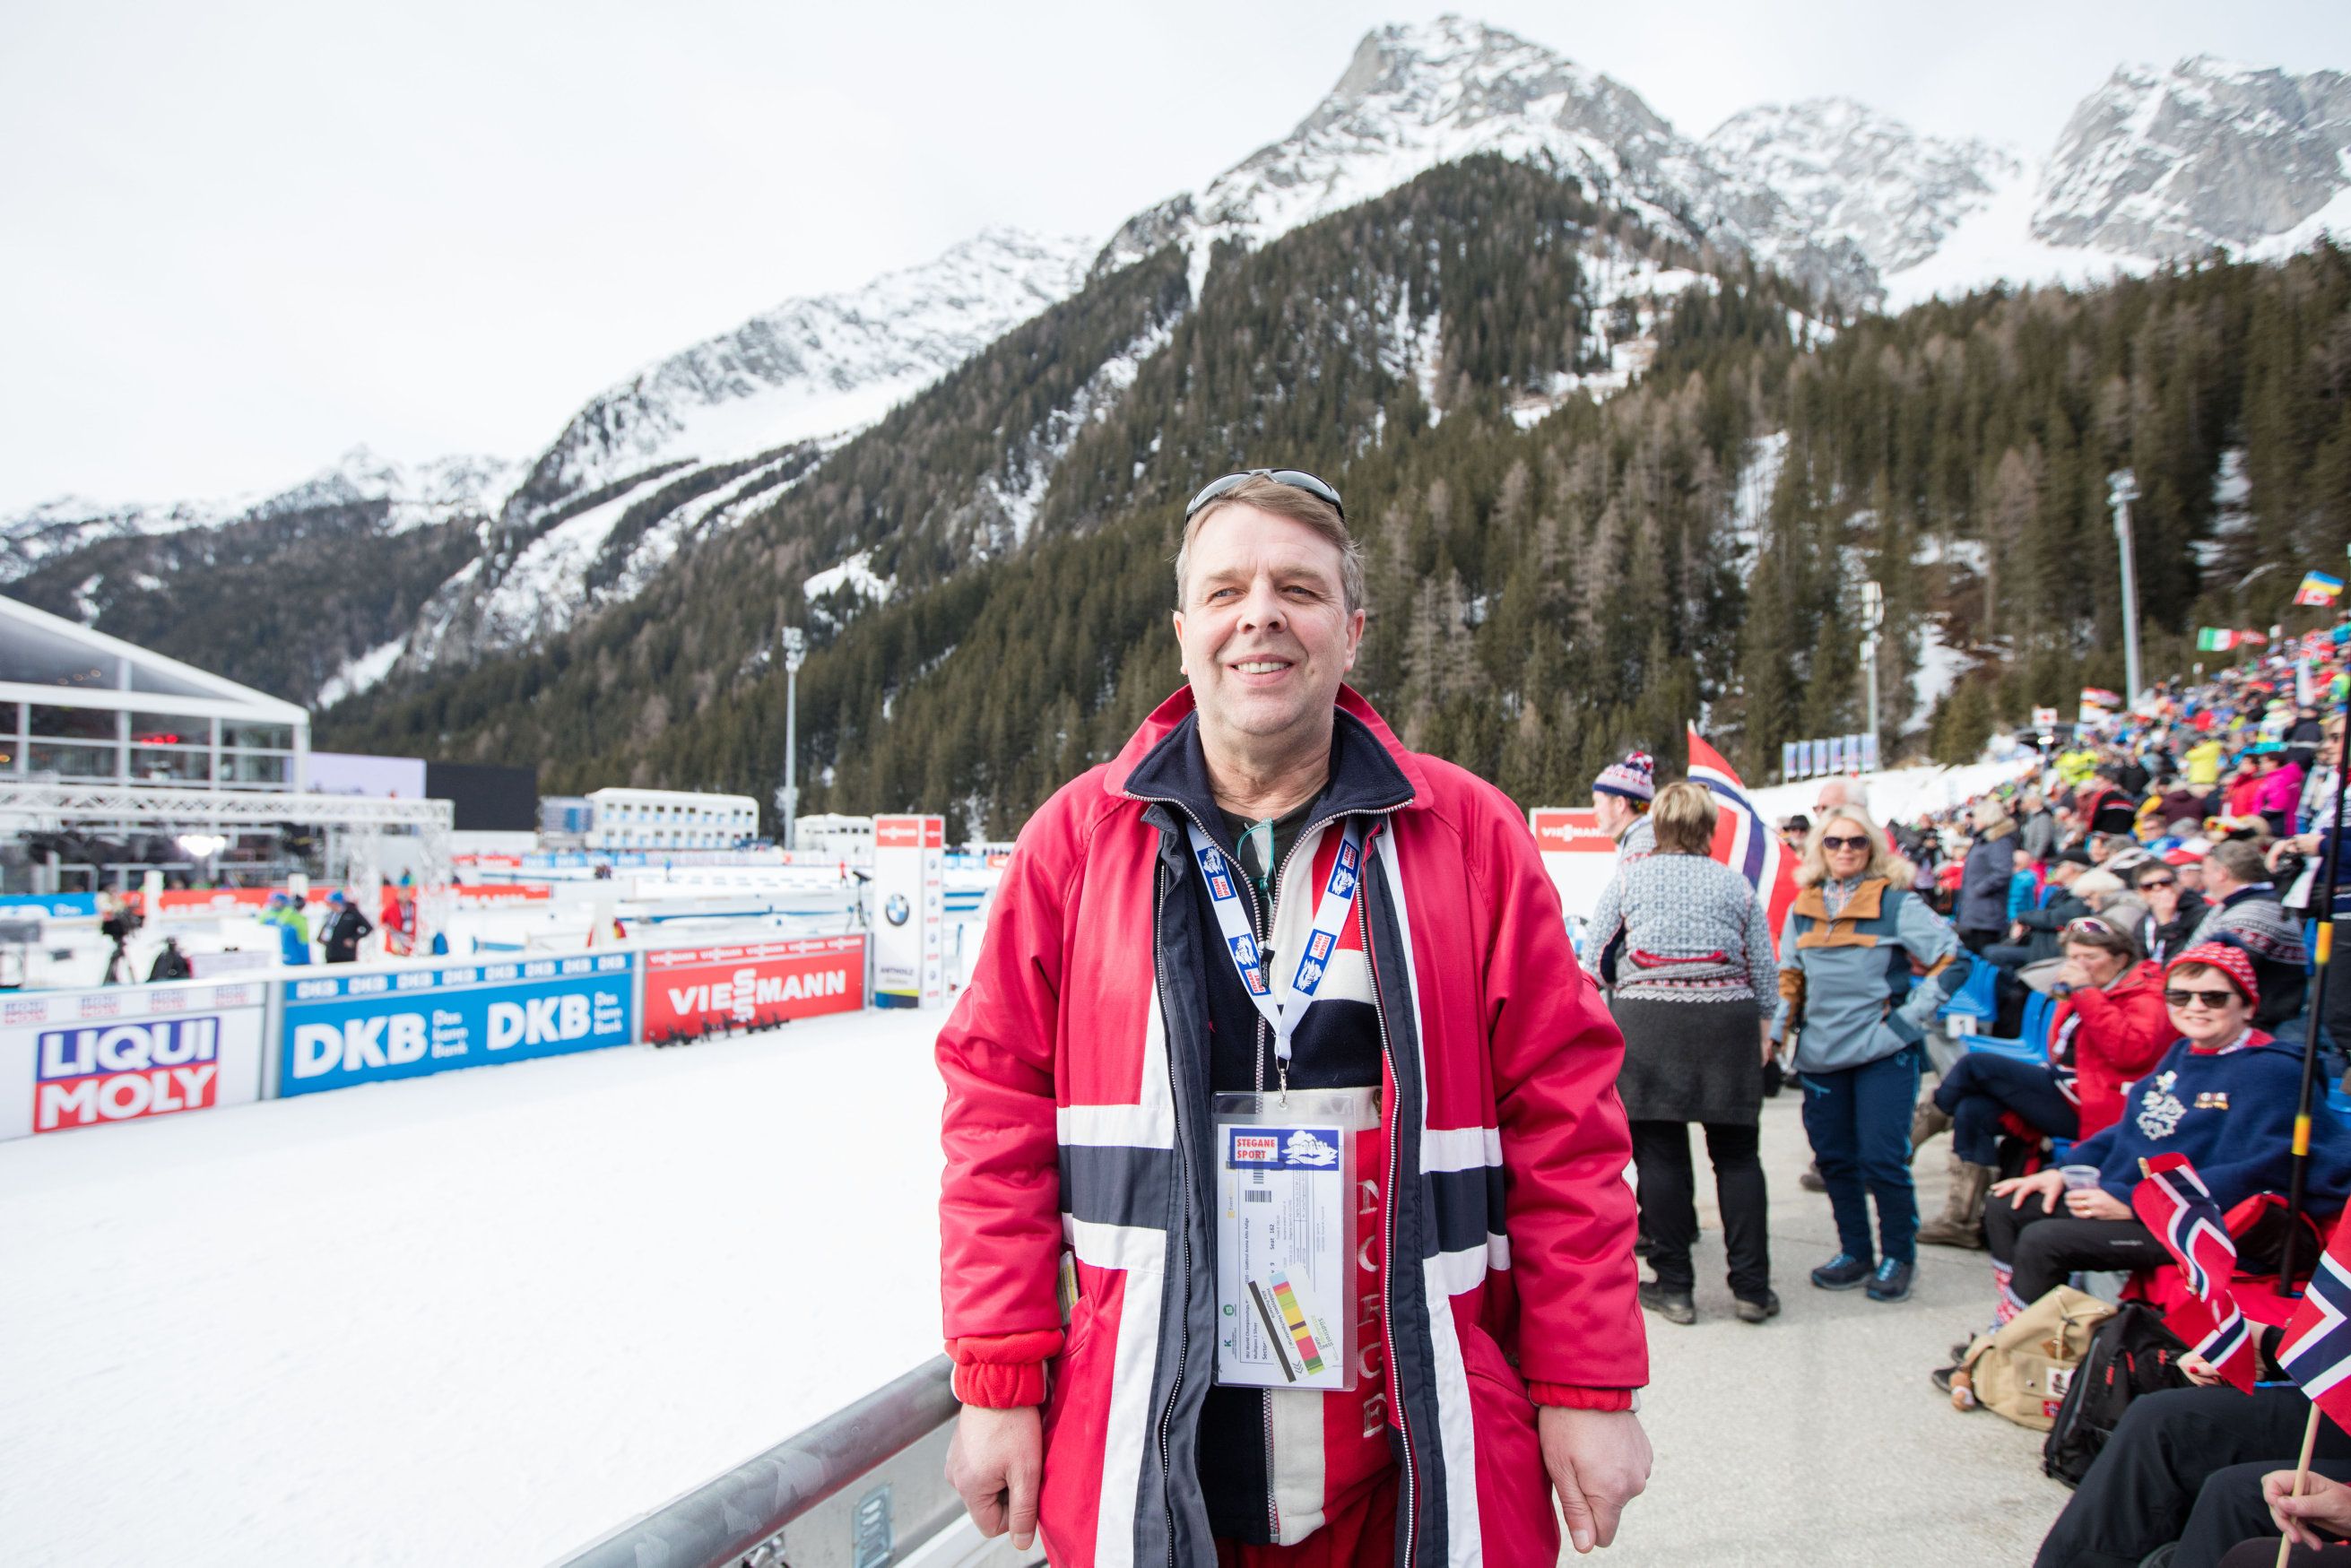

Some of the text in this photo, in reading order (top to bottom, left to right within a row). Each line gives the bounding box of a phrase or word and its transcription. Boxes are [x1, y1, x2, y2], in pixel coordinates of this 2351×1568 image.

[1212, 878, 1223, 897] STEGANE
[1220, 880, 1230, 897] SPORT
[1313, 934, 1323, 951] SPORT
[1318, 936, 1330, 958] STEGANE
[1246, 970, 1259, 992] STEGANE
[668, 968, 846, 1022] VIESSMANN
[487, 993, 591, 1050] DKB
[41, 1018, 217, 1079] LIQUI
[292, 1012, 428, 1079] DKB
[39, 1065, 218, 1130] MOLY
[1236, 1139, 1275, 1148] STEGANE
[1236, 1150, 1266, 1159] SPORT
